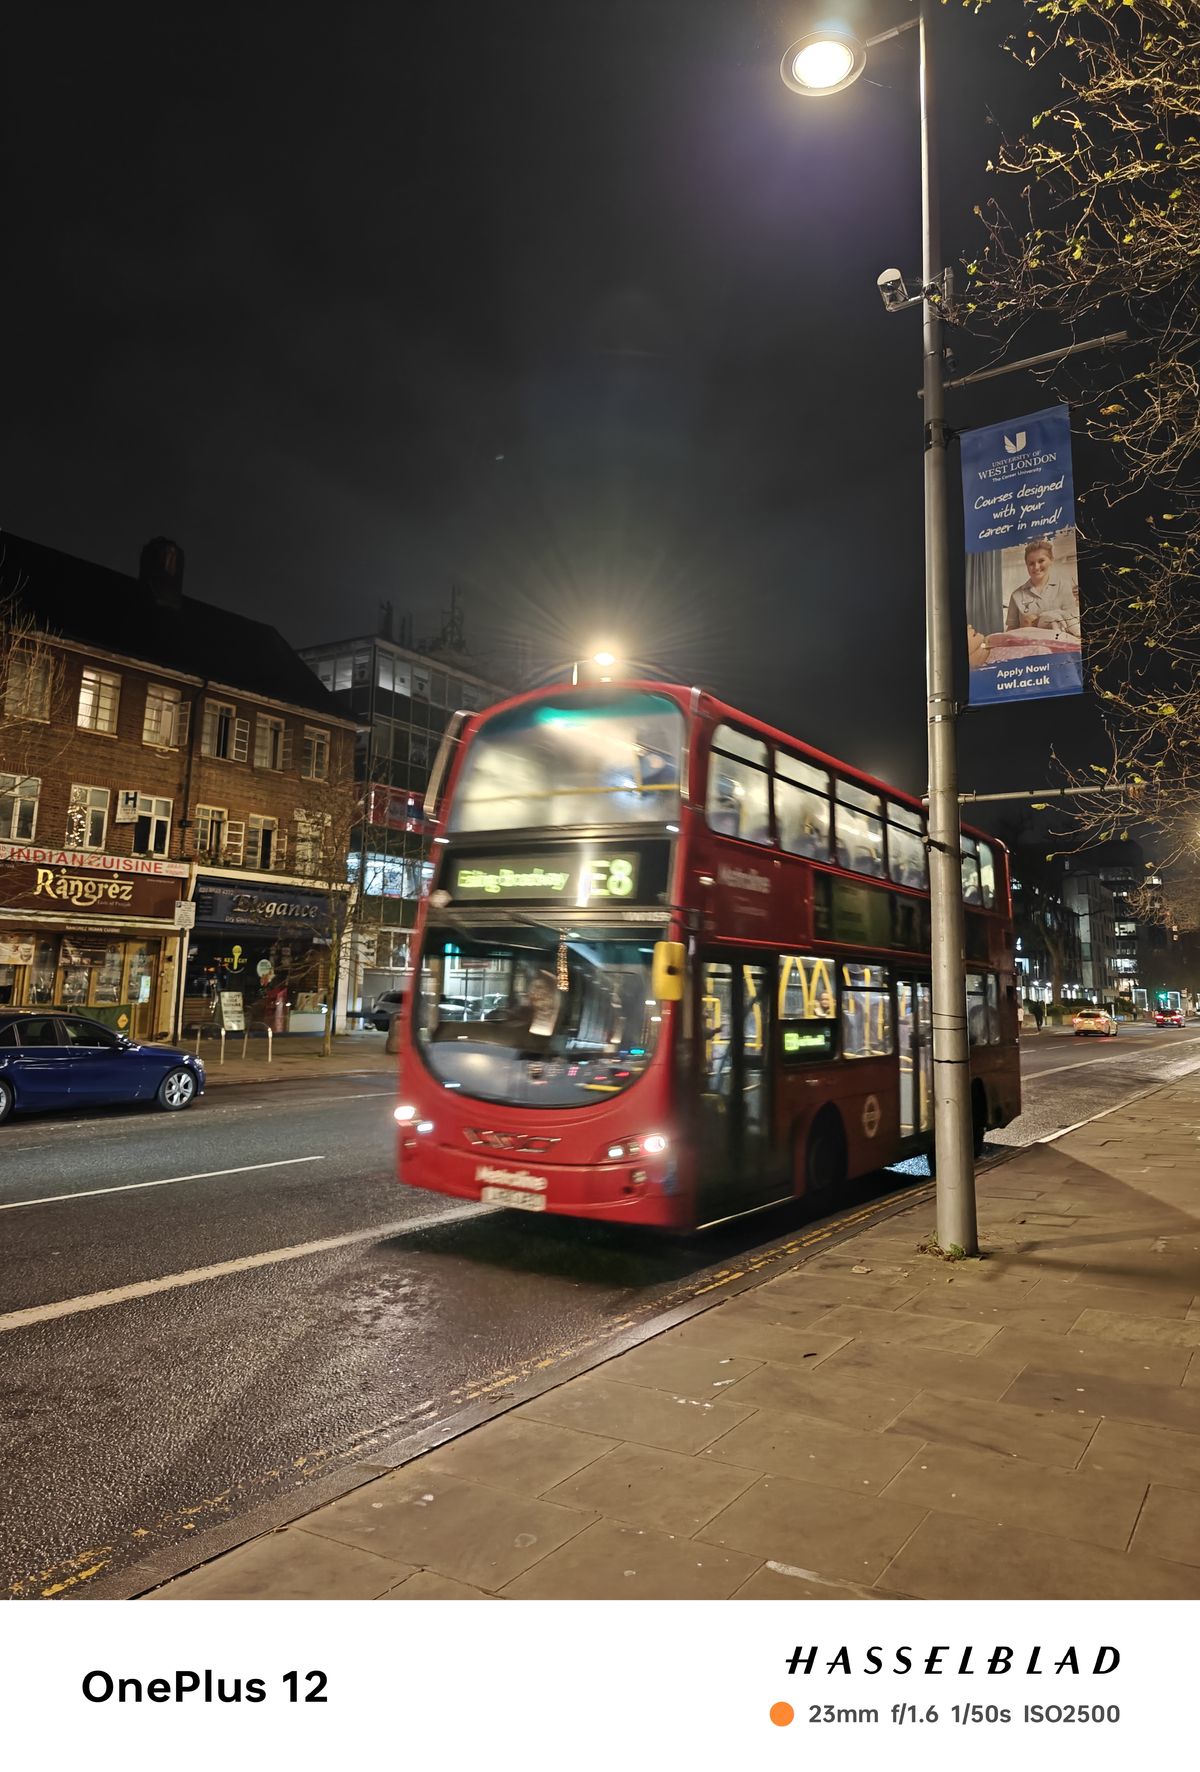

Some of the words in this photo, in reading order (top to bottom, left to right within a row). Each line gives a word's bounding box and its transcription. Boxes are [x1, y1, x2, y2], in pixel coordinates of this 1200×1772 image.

[978, 466, 1009, 480] WEST
[1010, 453, 1057, 471] LONDON
[992, 453, 1031, 467] UNIVERSITY
[1017, 467, 1042, 478] University
[974, 492, 1013, 510] Courses
[1017, 475, 1065, 498] designed
[992, 503, 1016, 519] with
[1020, 502, 1045, 519] your
[978, 524, 1013, 539] career
[1017, 520, 1027, 530] in
[1031, 507, 1062, 528] mind!
[996, 675, 1050, 690] uwl.ac.uk
[997, 667, 1023, 678] Apply
[1025, 663, 1050, 673] Now!
[10, 848, 84, 866] INDIAN
[88, 856, 163, 874] CUISINE
[582, 858, 634, 896] E8
[232, 894, 319, 918] Elegance
